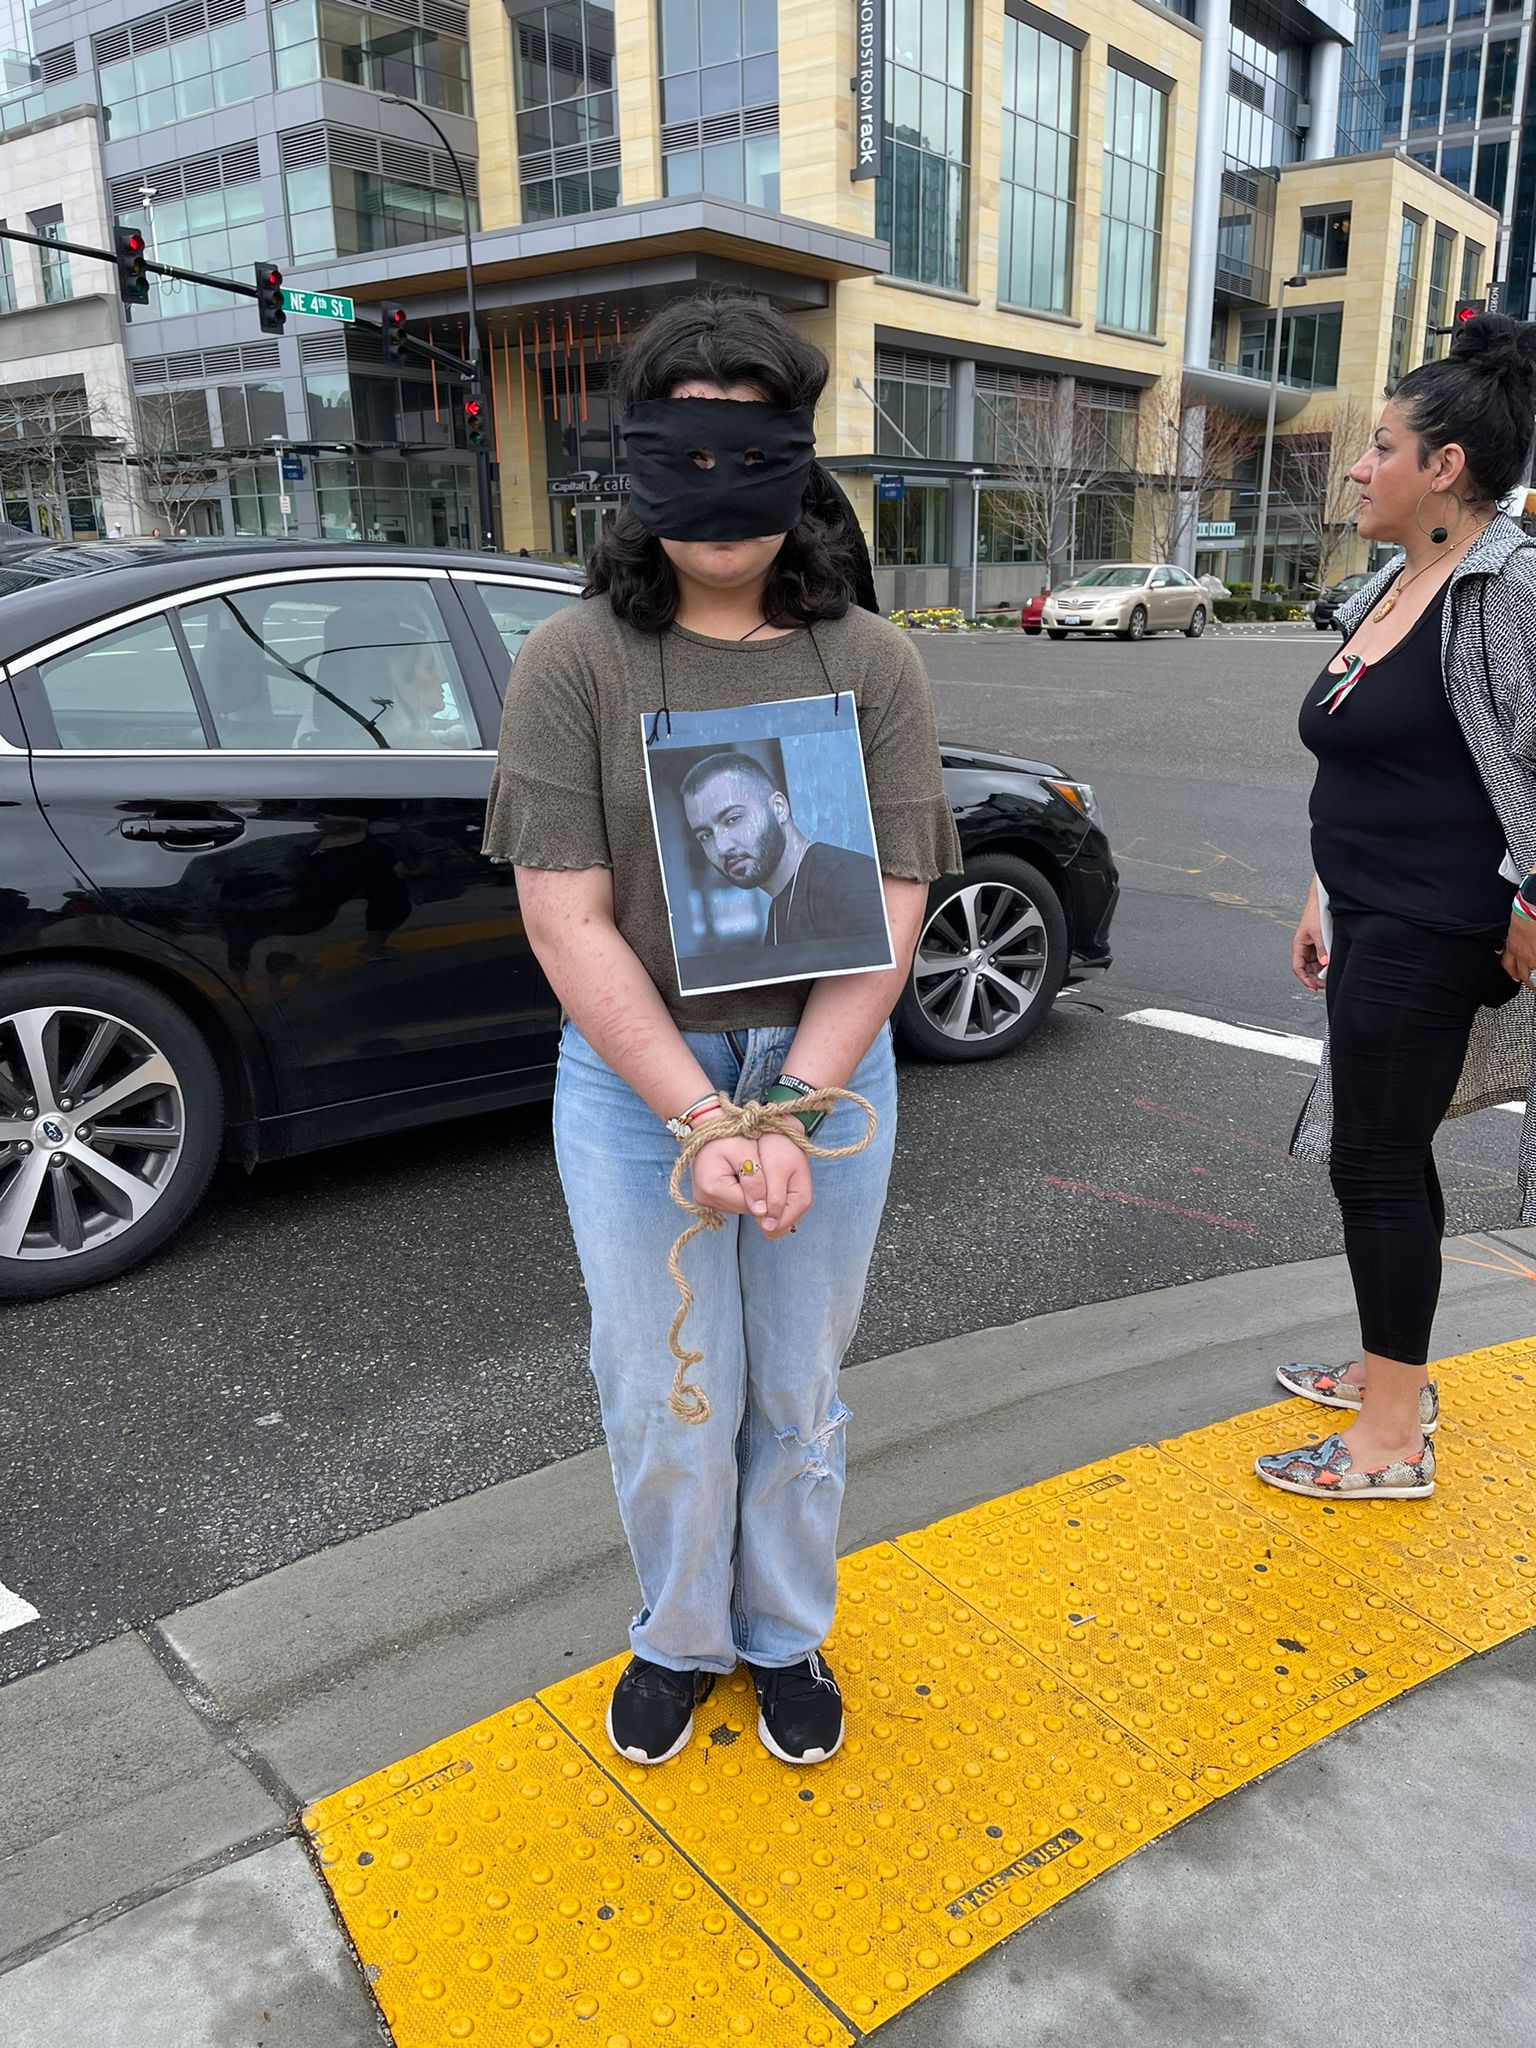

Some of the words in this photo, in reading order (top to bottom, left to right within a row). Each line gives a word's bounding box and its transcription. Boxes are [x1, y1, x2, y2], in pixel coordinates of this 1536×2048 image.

[860, 0, 874, 111] NORDSTROM
[860, 114, 877, 165] rack
[290, 292, 307, 311] NE
[310, 296, 327, 313] 4th
[331, 299, 344, 317] St
[1490, 287, 1499, 311] NORD
[1331, 1672, 1359, 1691] USA
[957, 1876, 1010, 1915] MADE
[1010, 1860, 1034, 1879] IN
[1036, 1837, 1073, 1863] USA
